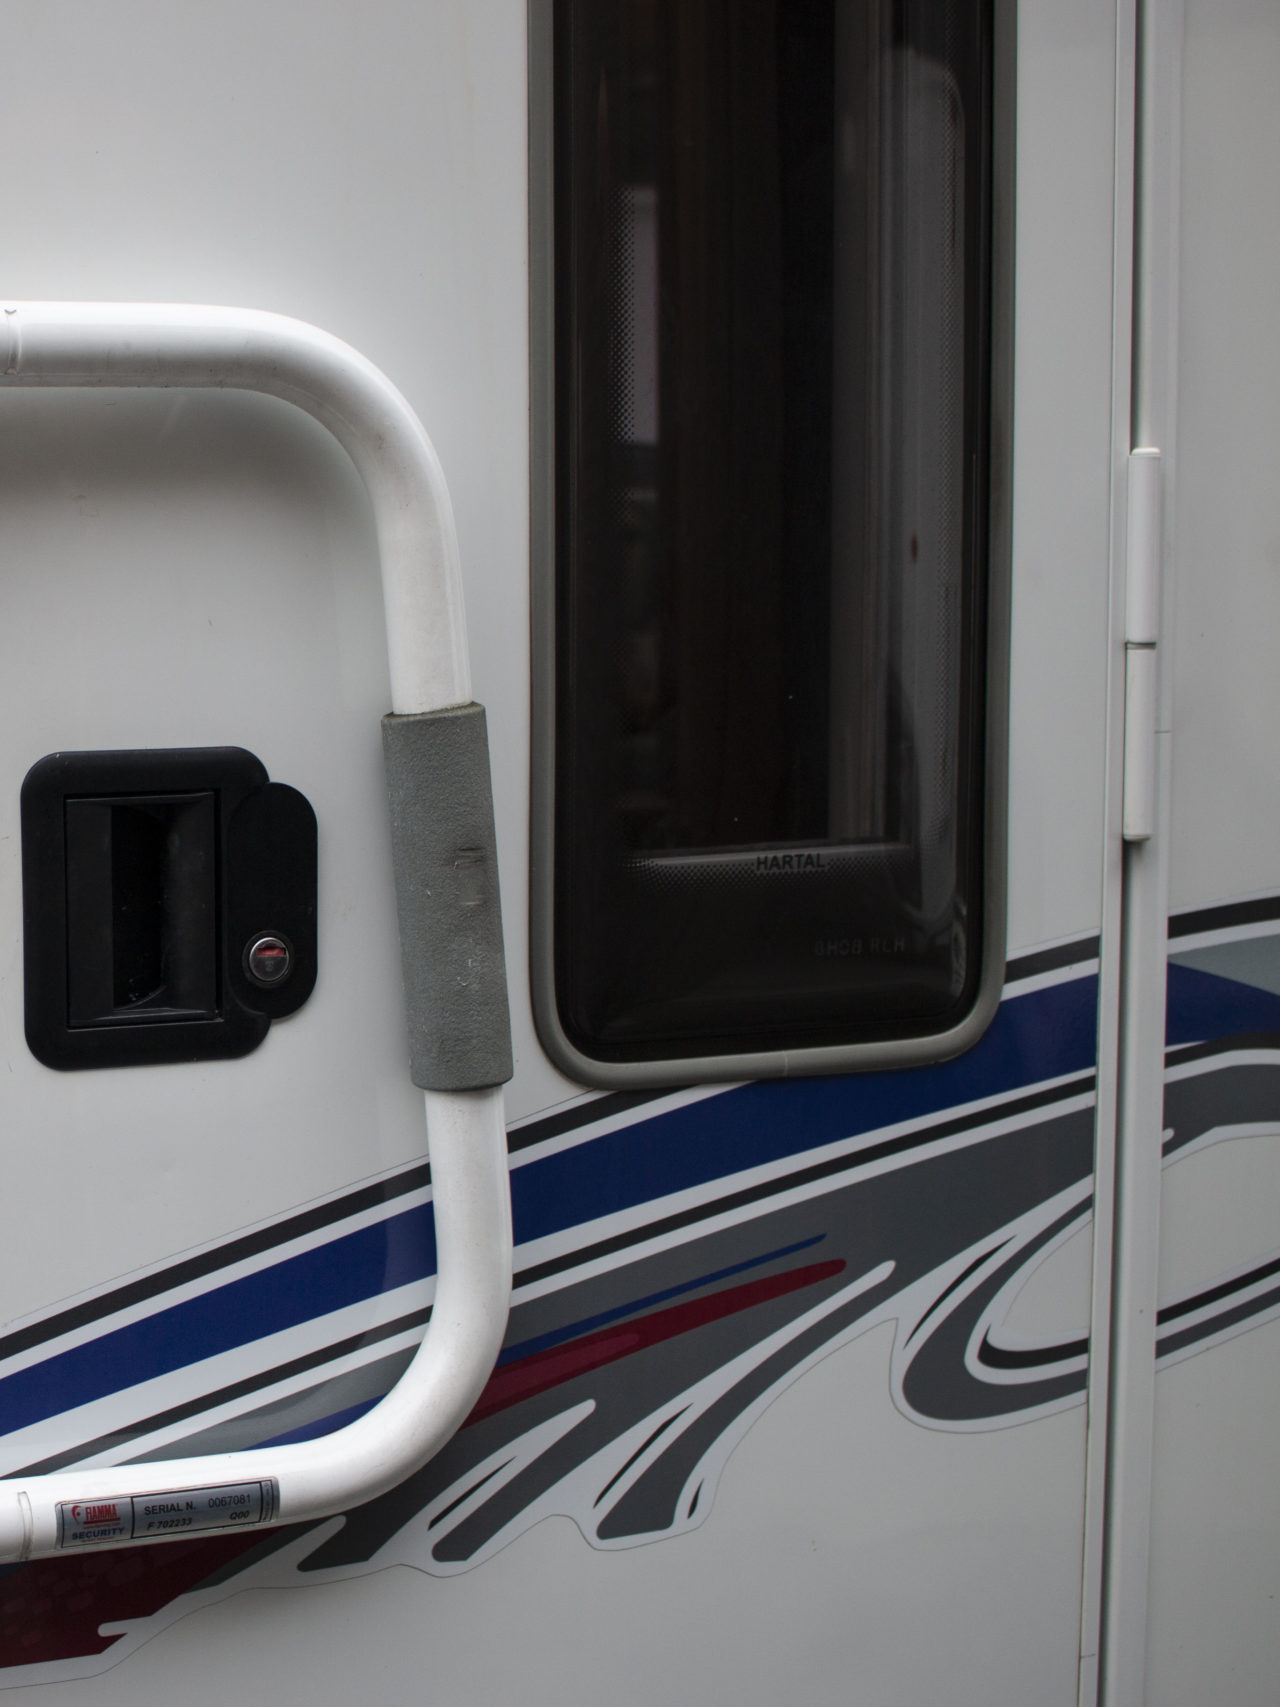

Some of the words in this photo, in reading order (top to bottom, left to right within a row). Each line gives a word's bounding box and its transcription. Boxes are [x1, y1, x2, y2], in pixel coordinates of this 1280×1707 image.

[756, 853, 826, 871] HARTAL
[85, 1503, 119, 1521] FIAMMA
[144, 1501, 184, 1516] SERIAL
[185, 1500, 197, 1511] N.
[207, 1493, 252, 1509] 0067081
[72, 1526, 124, 1541] SECURITY
